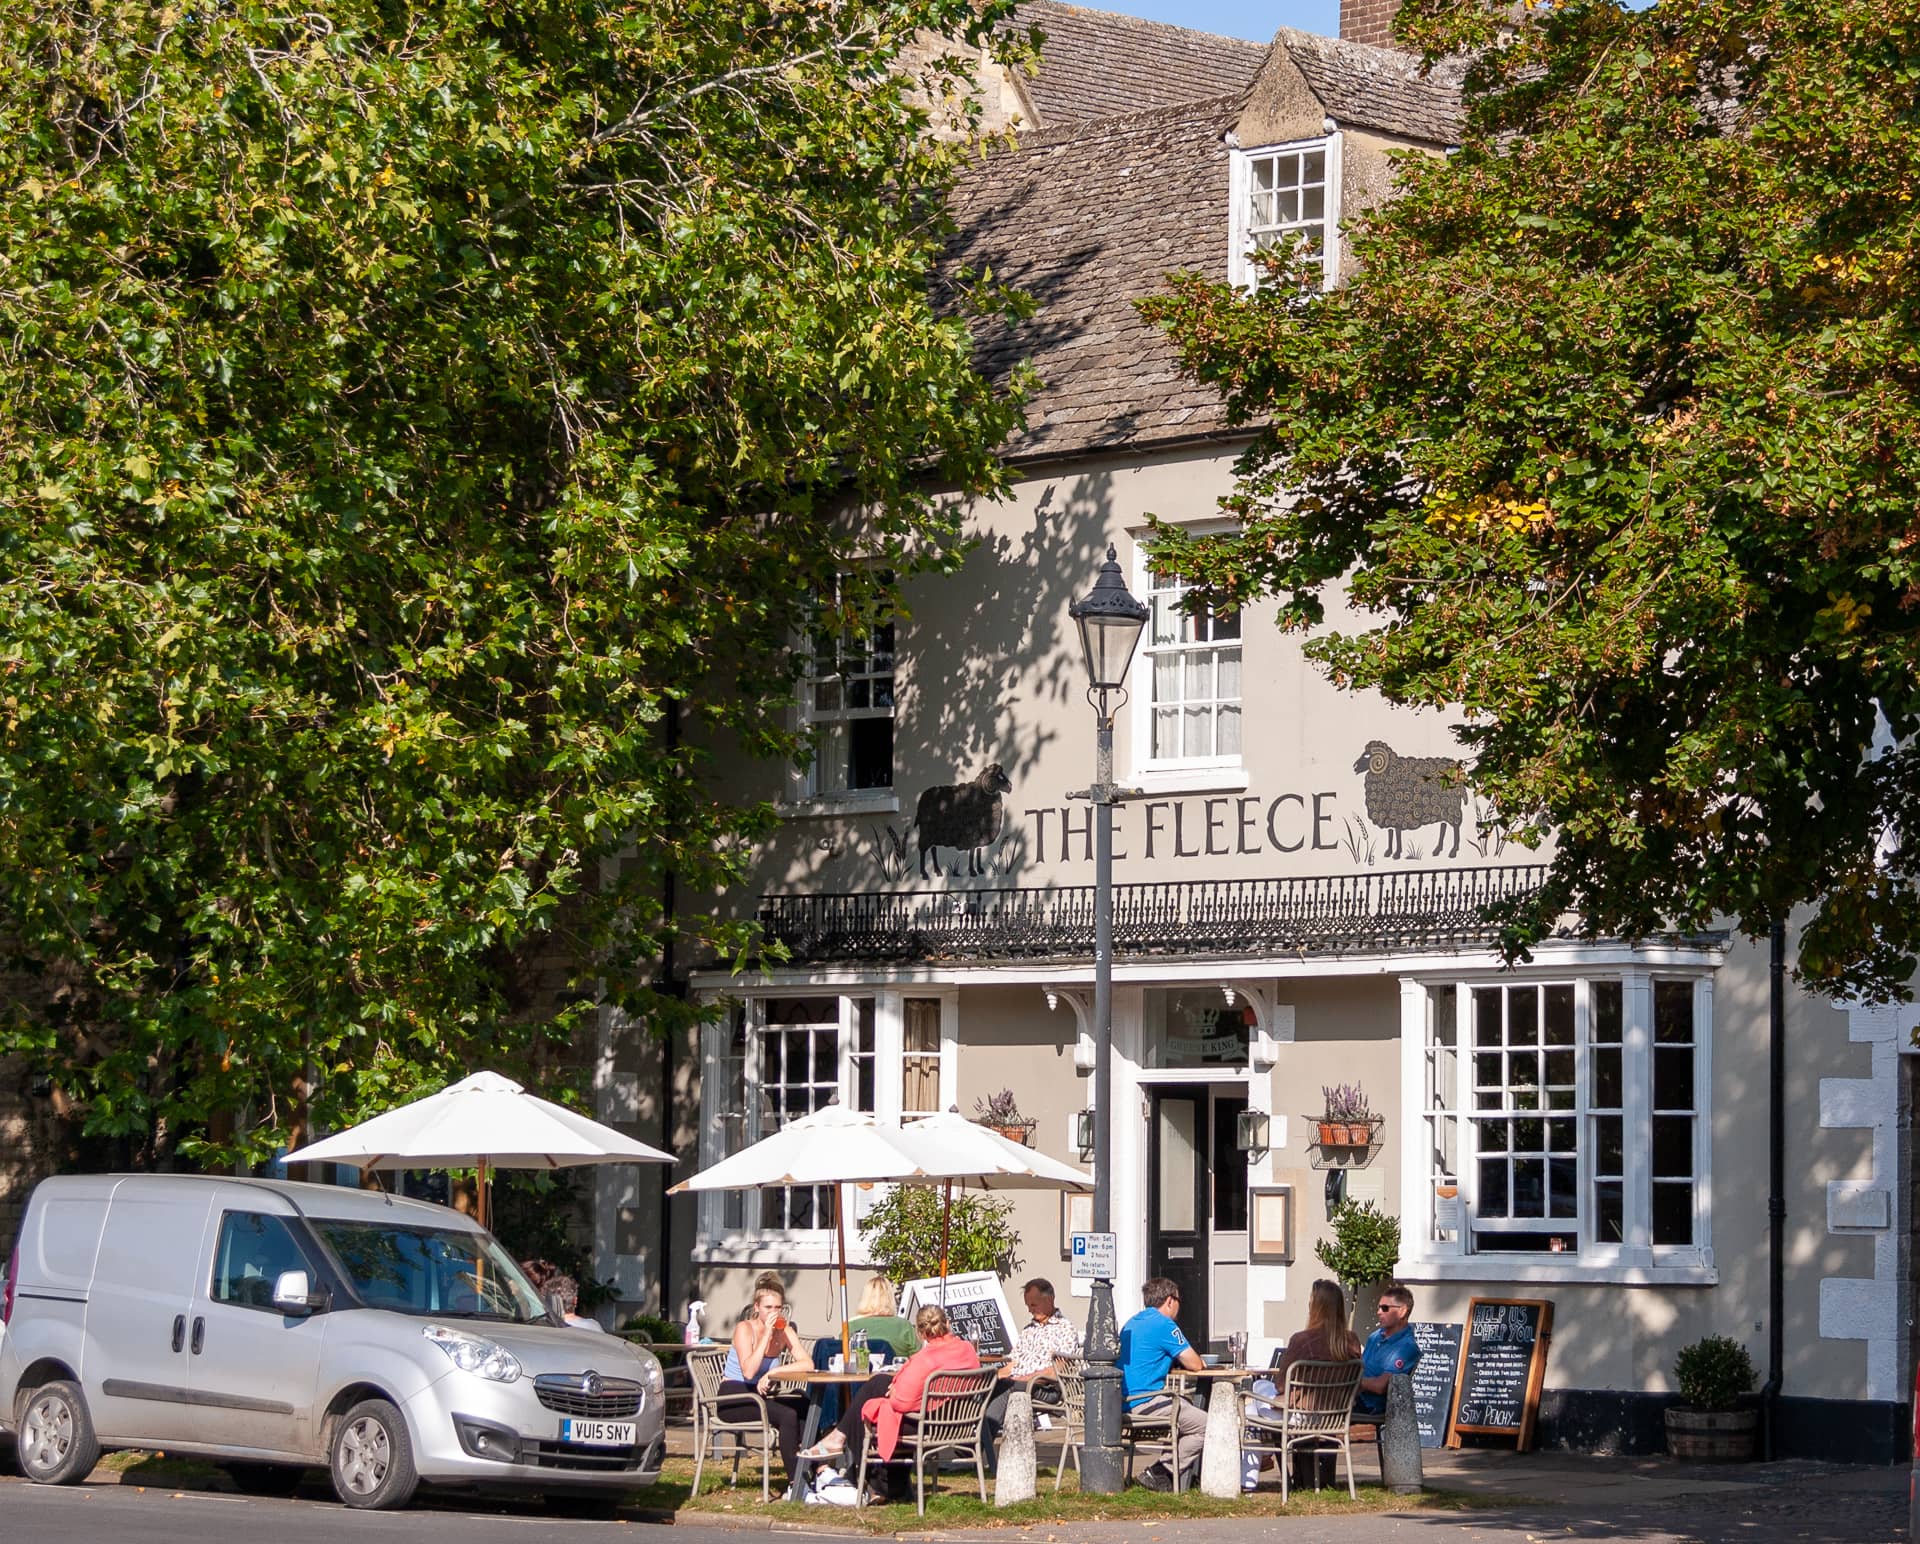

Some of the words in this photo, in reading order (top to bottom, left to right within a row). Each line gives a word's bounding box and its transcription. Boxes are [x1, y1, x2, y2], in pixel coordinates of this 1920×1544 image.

[1025, 803, 1127, 863] THE
[1145, 792, 1338, 859] FLEECE
[1096, 950, 1102, 961] 2
[1211, 1039, 1234, 1053] KING
[952, 1285, 984, 1298] FLEECE
[952, 1304, 971, 1320] ARE
[972, 1300, 998, 1318] OPEN
[1473, 1305, 1506, 1324] HELP
[1508, 1306, 1528, 1325] US
[1171, 1327, 1185, 1345] 7
[1482, 1324, 1507, 1341] HELP
[1461, 1404, 1481, 1423] STAY
[576, 1422, 603, 1439] VU15
[606, 1424, 630, 1440] SNY
